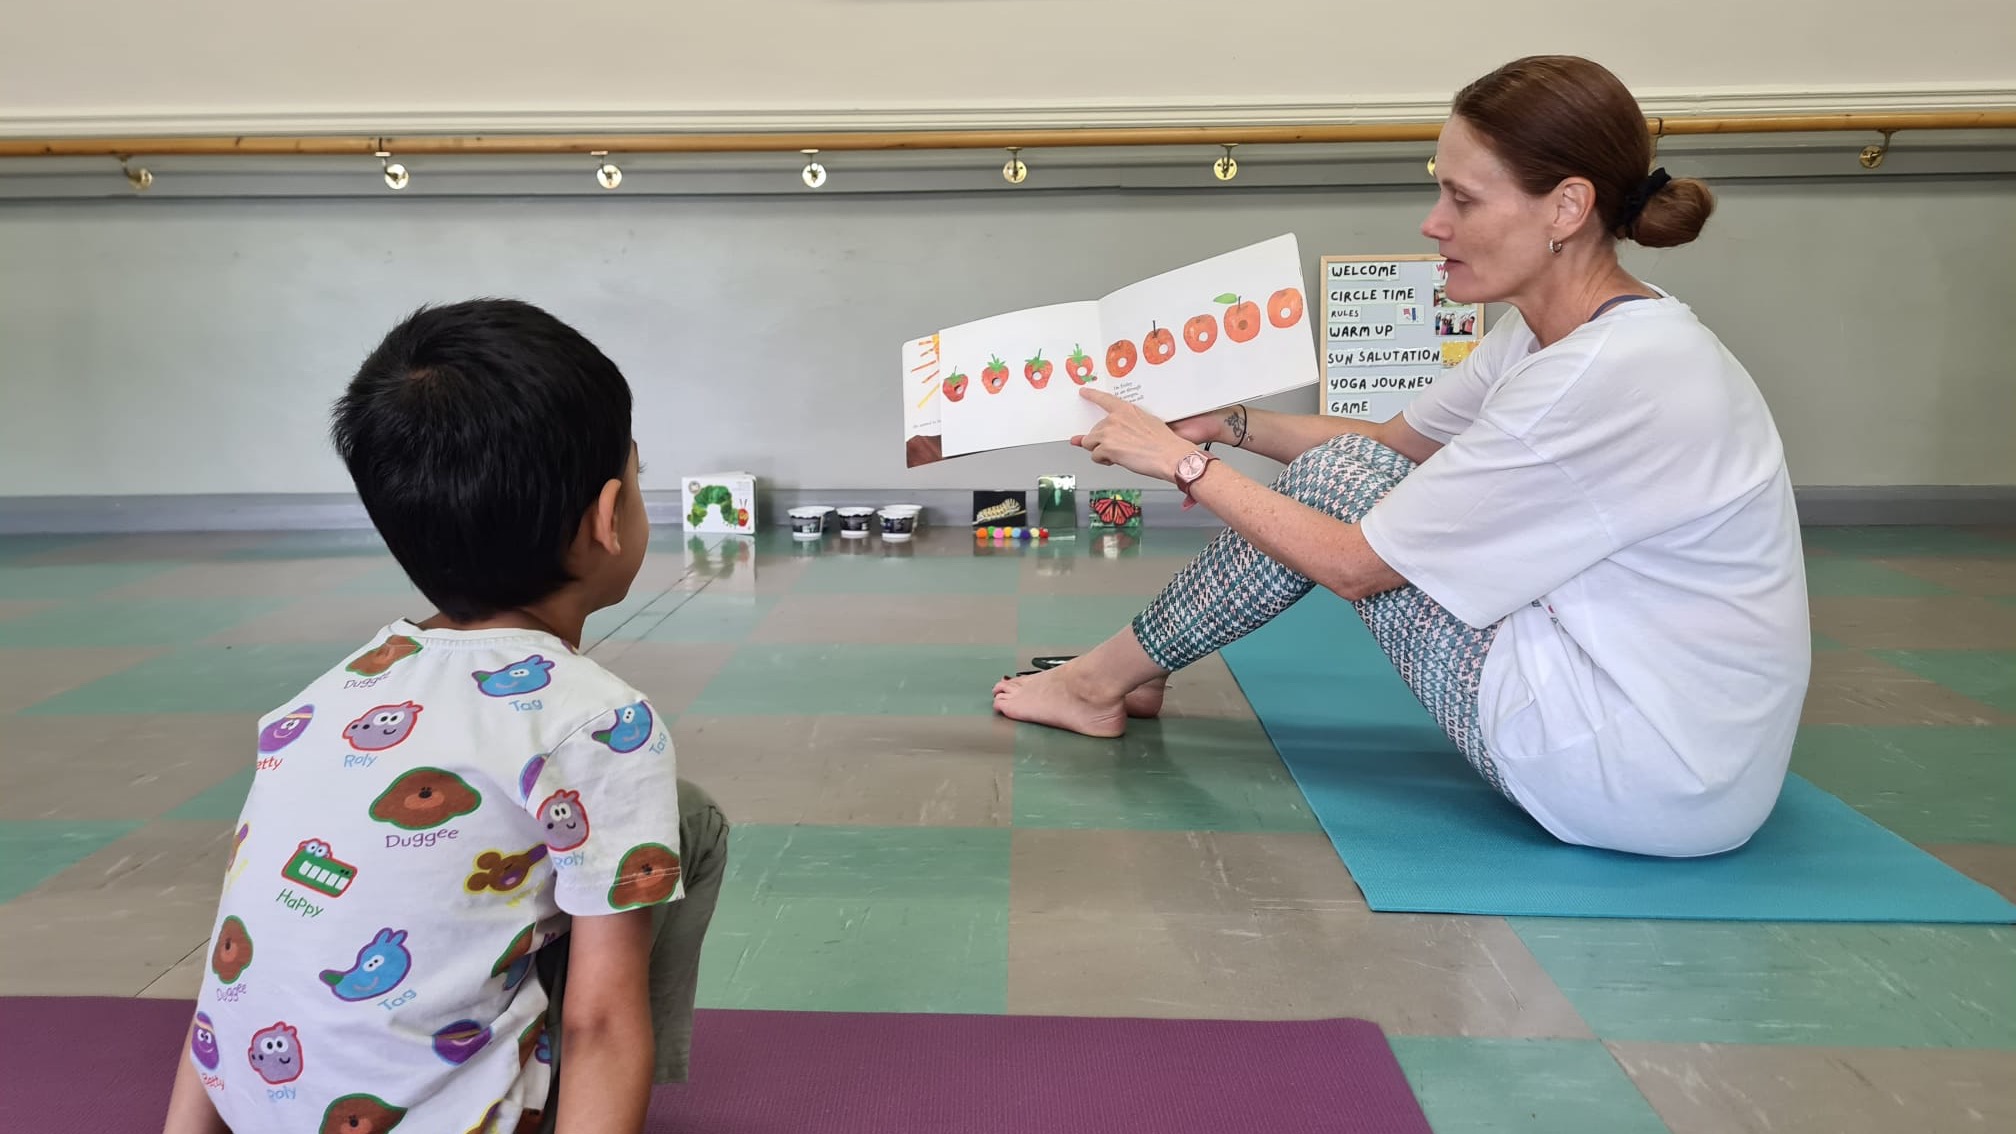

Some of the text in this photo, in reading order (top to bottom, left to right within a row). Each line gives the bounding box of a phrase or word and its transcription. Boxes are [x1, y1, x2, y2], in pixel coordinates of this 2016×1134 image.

[1331, 264, 1397, 277] WELCOME
[1330, 288, 1415, 303] CIRCLE TIME
[1330, 309, 1359, 318] RULES
[1329, 324, 1393, 338] WARM UP
[1327, 349, 1440, 365] SUN SALUTATION
[1330, 378, 1367, 390] YOGA
[1331, 401, 1369, 414] GAME
[508, 699, 543, 712] Tag
[649, 732, 668, 755] Tag
[256, 756, 284, 771] etty
[343, 753, 378, 768] Roly
[385, 828, 460, 848] Duggee
[275, 888, 325, 918] Happy
[216, 983, 247, 1002] Duggee
[376, 988, 417, 1011] Tag
